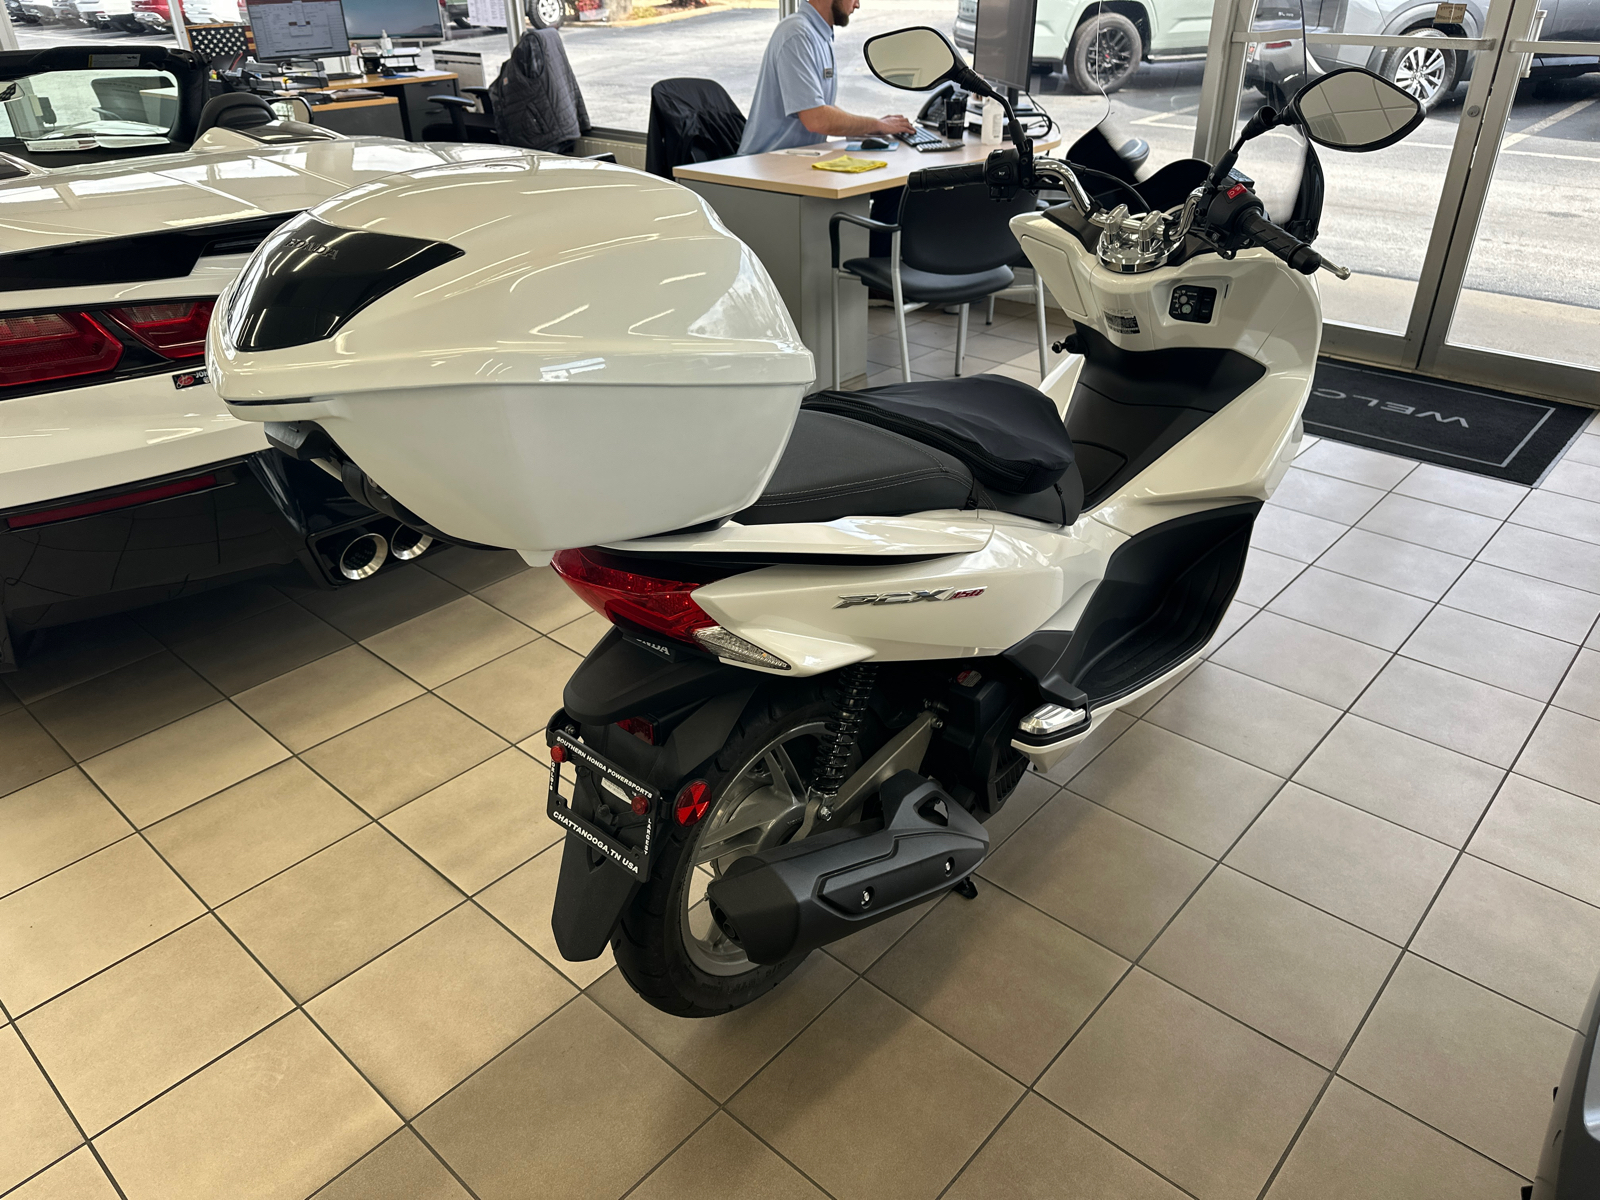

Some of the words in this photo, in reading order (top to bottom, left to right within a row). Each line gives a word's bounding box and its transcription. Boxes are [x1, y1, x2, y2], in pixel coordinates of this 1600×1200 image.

[284, 238, 339, 260] HONDA
[556, 736, 586, 758] SOUTHERN
[586, 754, 607, 772] HONDA
[607, 768, 653, 799] POWERSPORTS
[644, 818, 652, 855] LARGEST
[622, 858, 639, 874] USA
